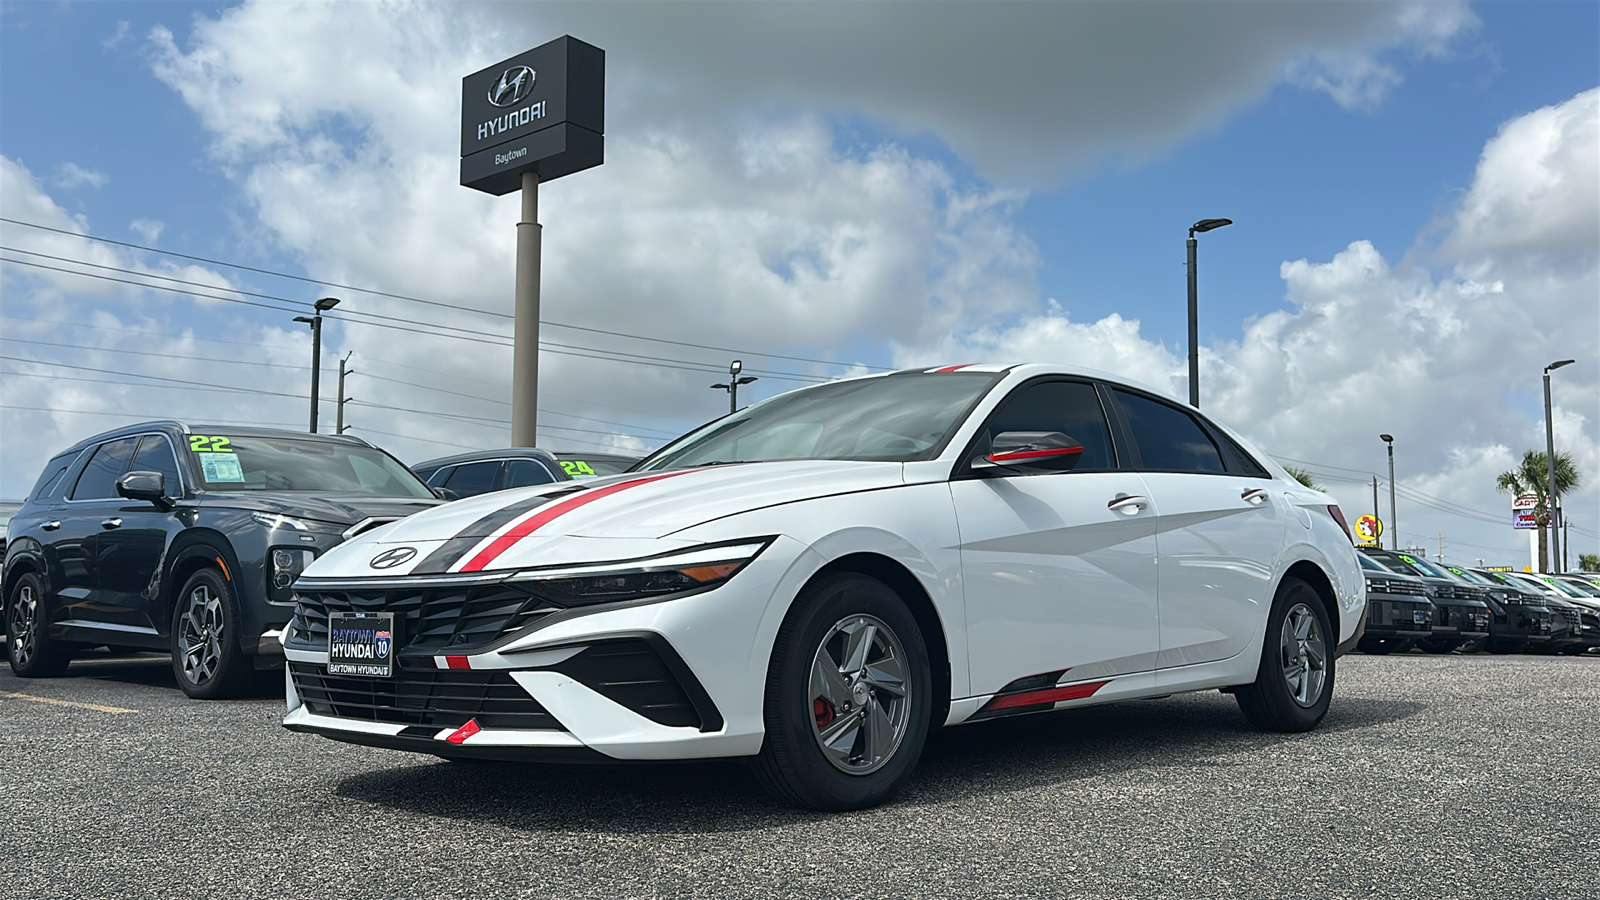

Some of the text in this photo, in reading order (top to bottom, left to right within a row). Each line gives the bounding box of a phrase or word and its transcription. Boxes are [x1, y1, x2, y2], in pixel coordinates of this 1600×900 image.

[477, 100, 546, 141] HYUNDAI
[495, 147, 527, 165] Baytown
[189, 435, 233, 452] 22
[559, 461, 595, 475] 24
[332, 629, 375, 643] BAYTOWN
[332, 641, 387, 659] HYUNDAI 10
[330, 664, 357, 674] BAYTOWN
